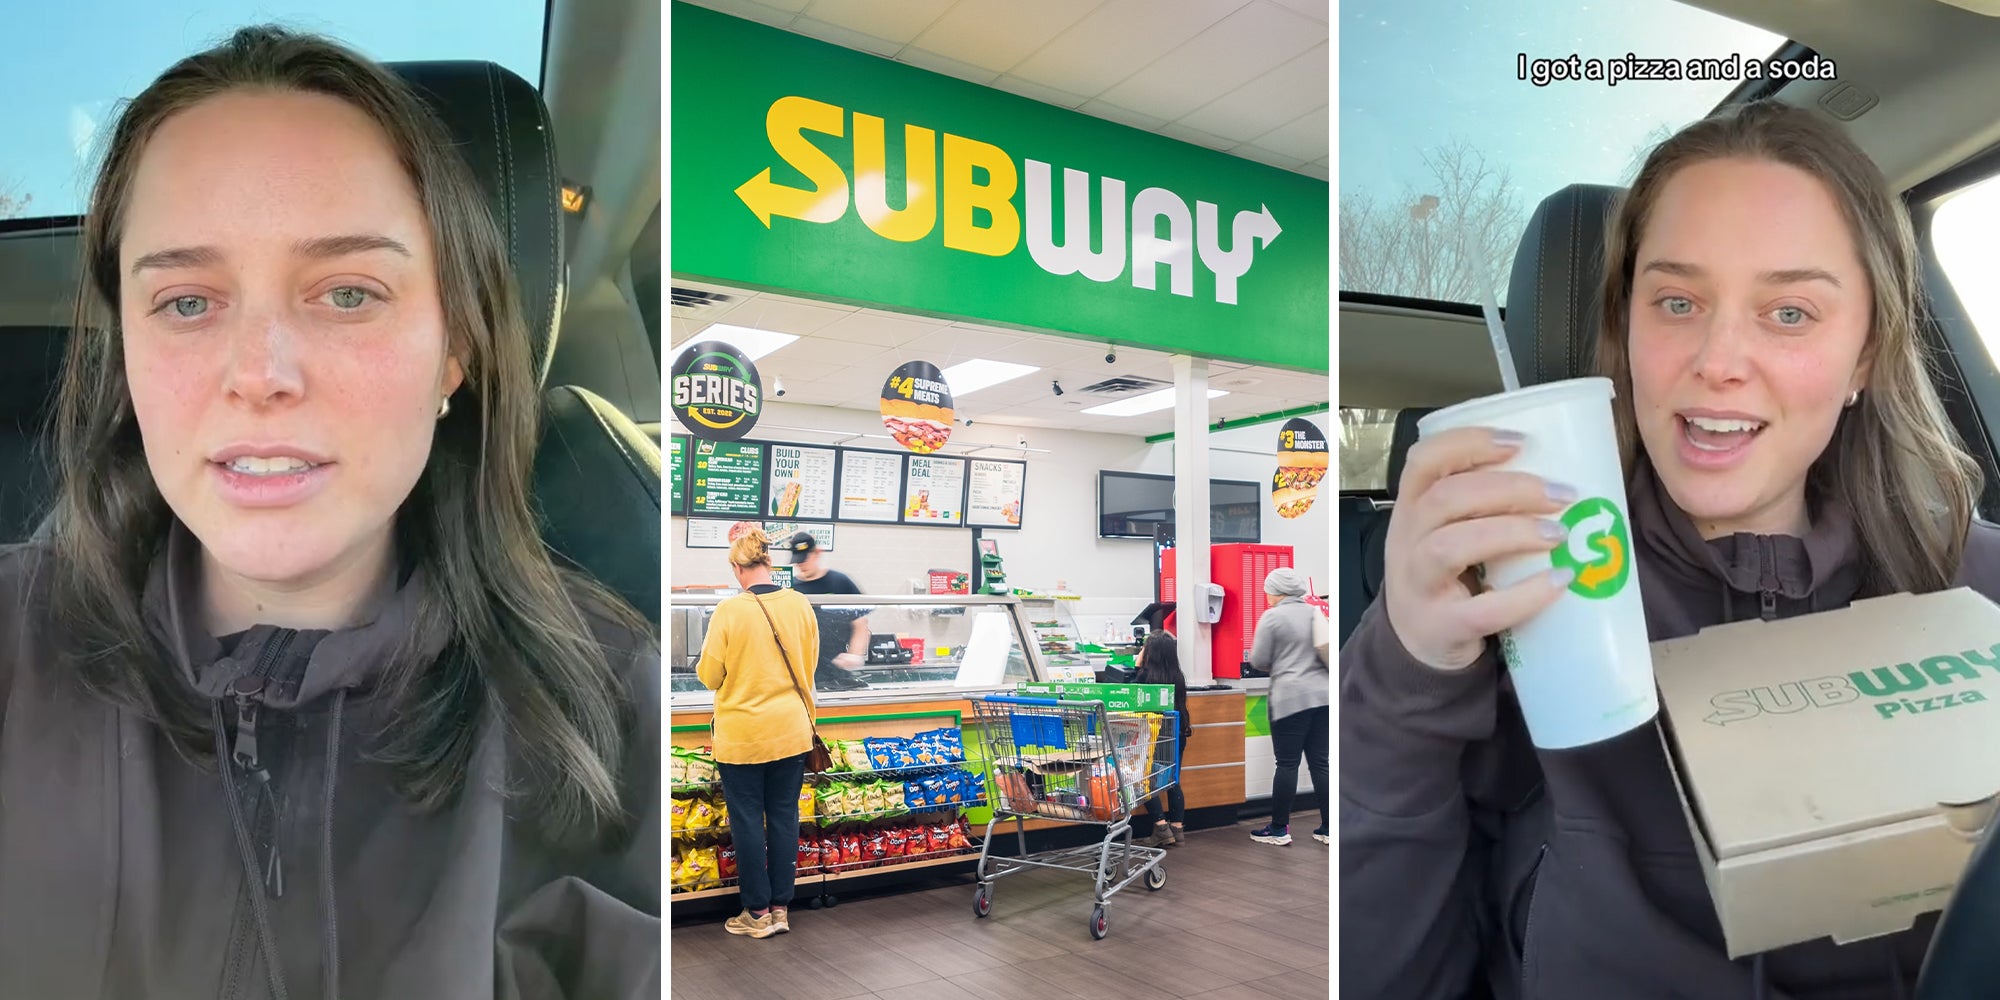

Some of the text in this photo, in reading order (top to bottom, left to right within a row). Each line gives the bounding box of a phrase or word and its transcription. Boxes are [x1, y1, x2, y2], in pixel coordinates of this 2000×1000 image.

[735, 96, 1282, 305] SUBWAY
[703, 363, 733, 373] SUBWAY
[890, 376, 915, 398] #4
[914, 378, 949, 395] SUPREME
[674, 374, 758, 414] SERIES
[914, 390, 940, 404] MEATS
[1294, 431, 1306, 440] THE
[1294, 440, 1325, 450] MONSTER
[776, 448, 800, 458] BUILD
[776, 458, 799, 469] YOUR
[912, 459, 931, 468] MEAL
[974, 463, 1002, 472] SNACKS
[774, 469, 793, 478] OWN
[912, 468, 930, 478] DEAL
[1109, 700, 1129, 708] VIZIO
[1874, 689, 1988, 719] Pizza
